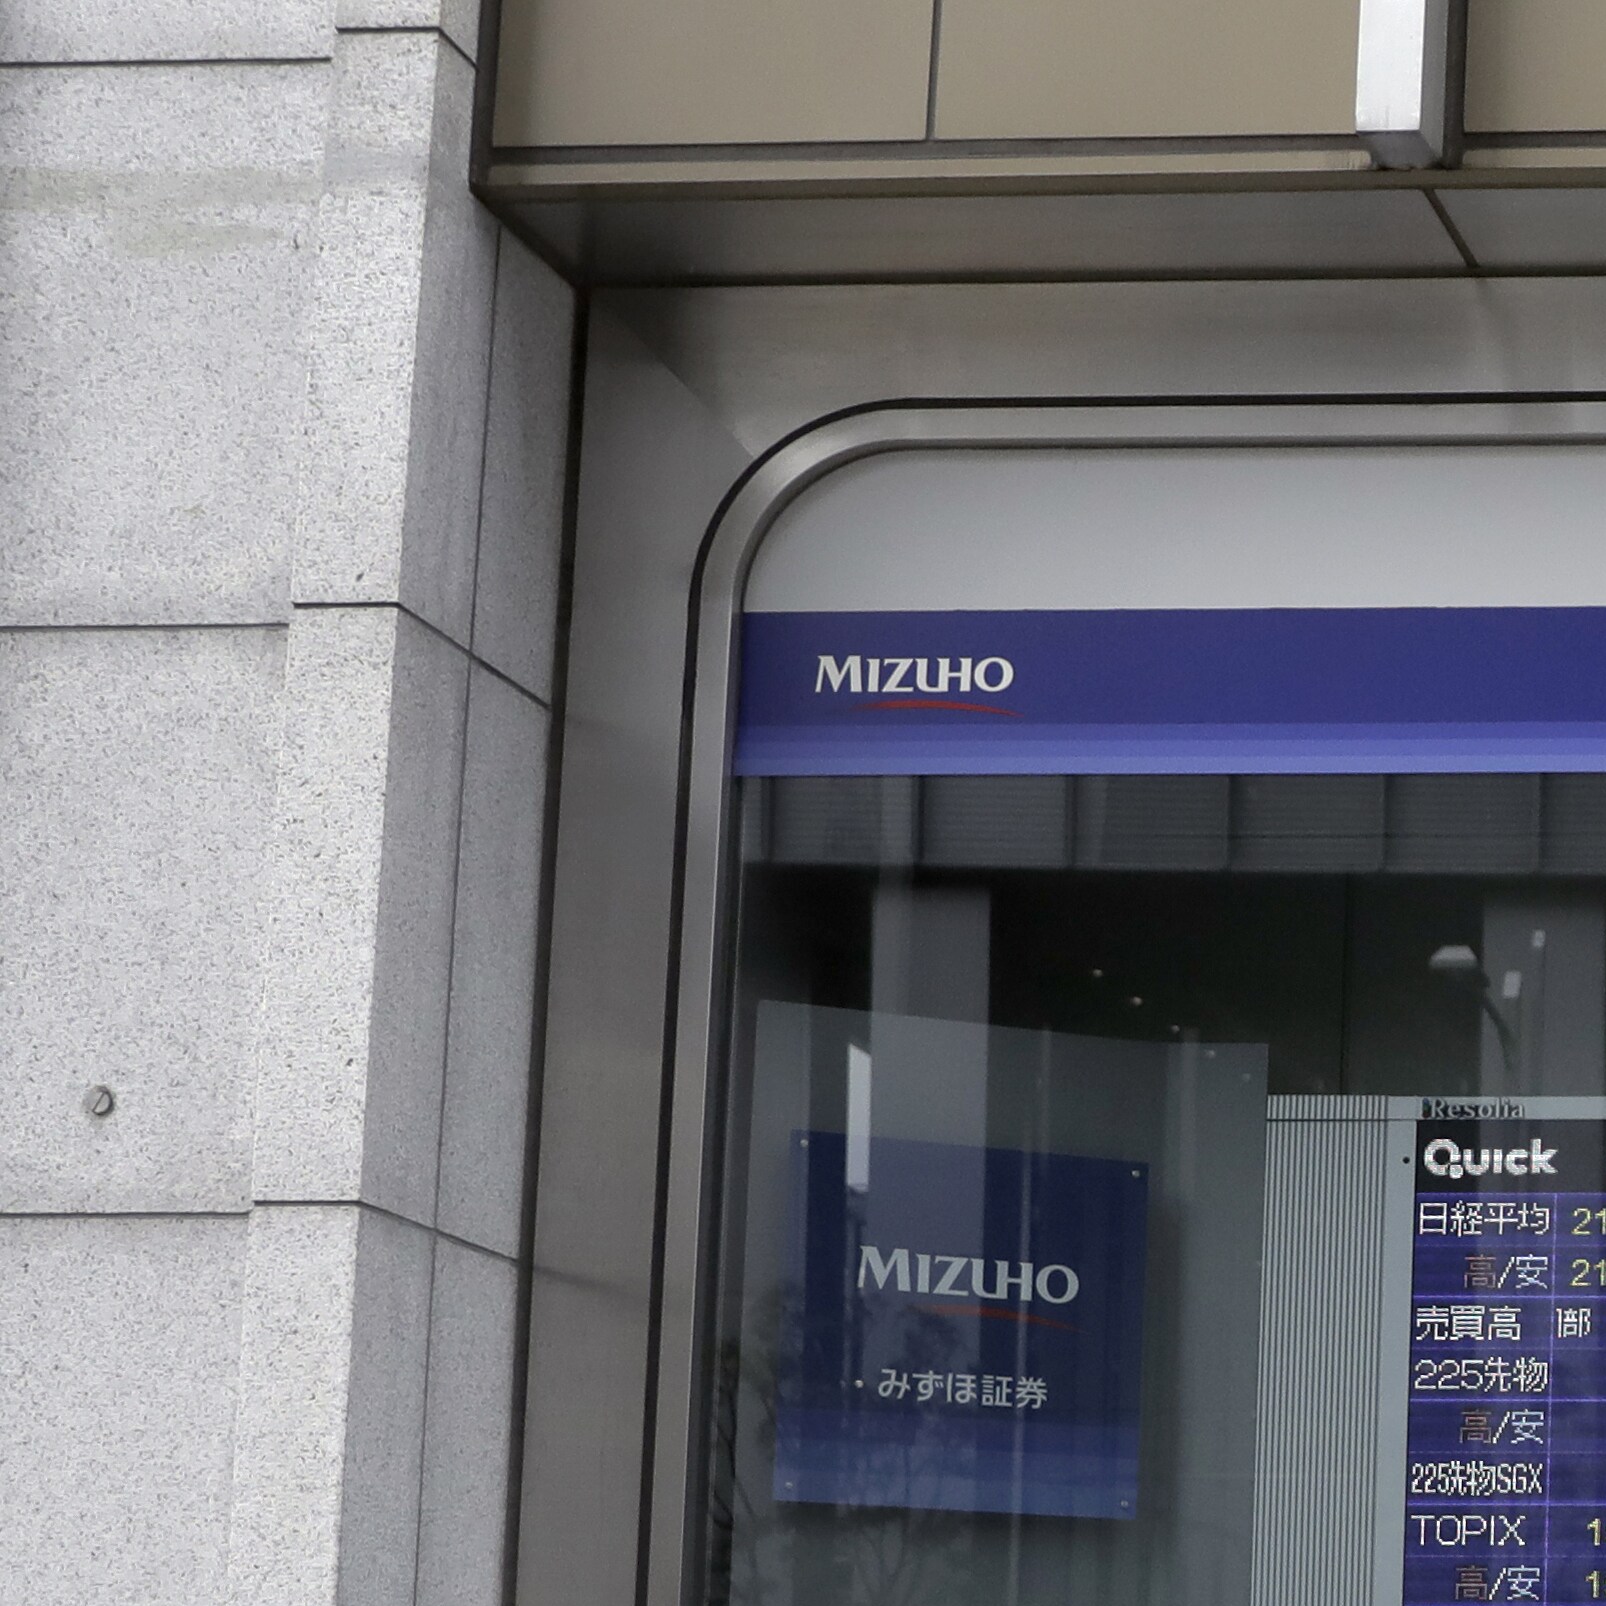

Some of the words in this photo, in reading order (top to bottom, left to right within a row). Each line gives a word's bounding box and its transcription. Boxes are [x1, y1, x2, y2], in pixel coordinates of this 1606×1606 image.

[814, 654, 1014, 693] MIZUHO
[1429, 1098, 1525, 1118] Resolia
[1423, 1138, 1559, 1179] Quick
[1419, 1199, 1550, 1238] 日経平均
[857, 1244, 1080, 1305] MIZUHO
[1464, 1253, 1549, 1290] 高/安
[1415, 1305, 1522, 1341] 売買高
[877, 1367, 1048, 1410] みずほ証券
[1414, 1356, 1548, 1393] 225先物
[1460, 1408, 1545, 1445] 高/安
[1410, 1514, 1527, 1547] TOPIX
[1455, 1564, 1541, 1601] 高/安
